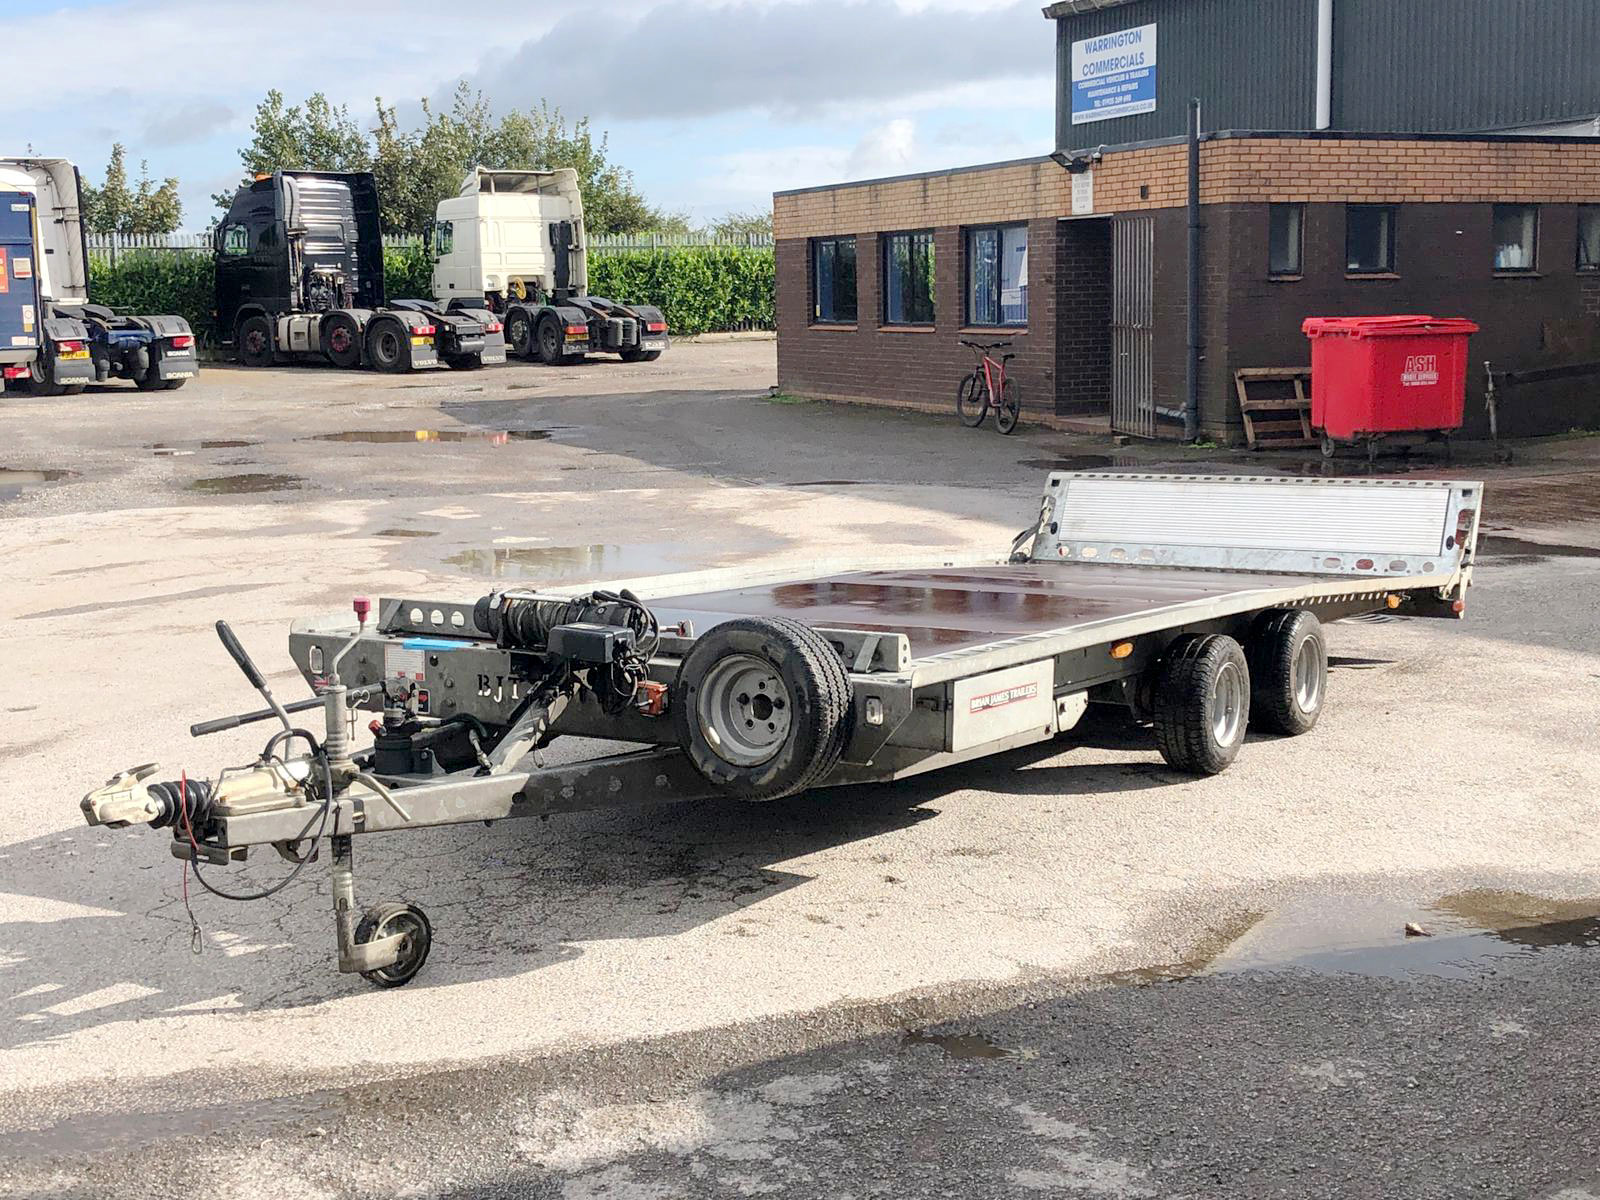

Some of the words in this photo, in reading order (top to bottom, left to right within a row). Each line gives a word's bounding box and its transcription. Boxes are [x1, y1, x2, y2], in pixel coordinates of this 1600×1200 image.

[1085, 30, 1142, 54] WARRINGTON
[1082, 52, 1145, 76] COMMERCIALS
[1405, 355, 1436, 373] ASH
[166, 371, 193, 379] SCANIA
[1010, 685, 1037, 699] TRAILERS
